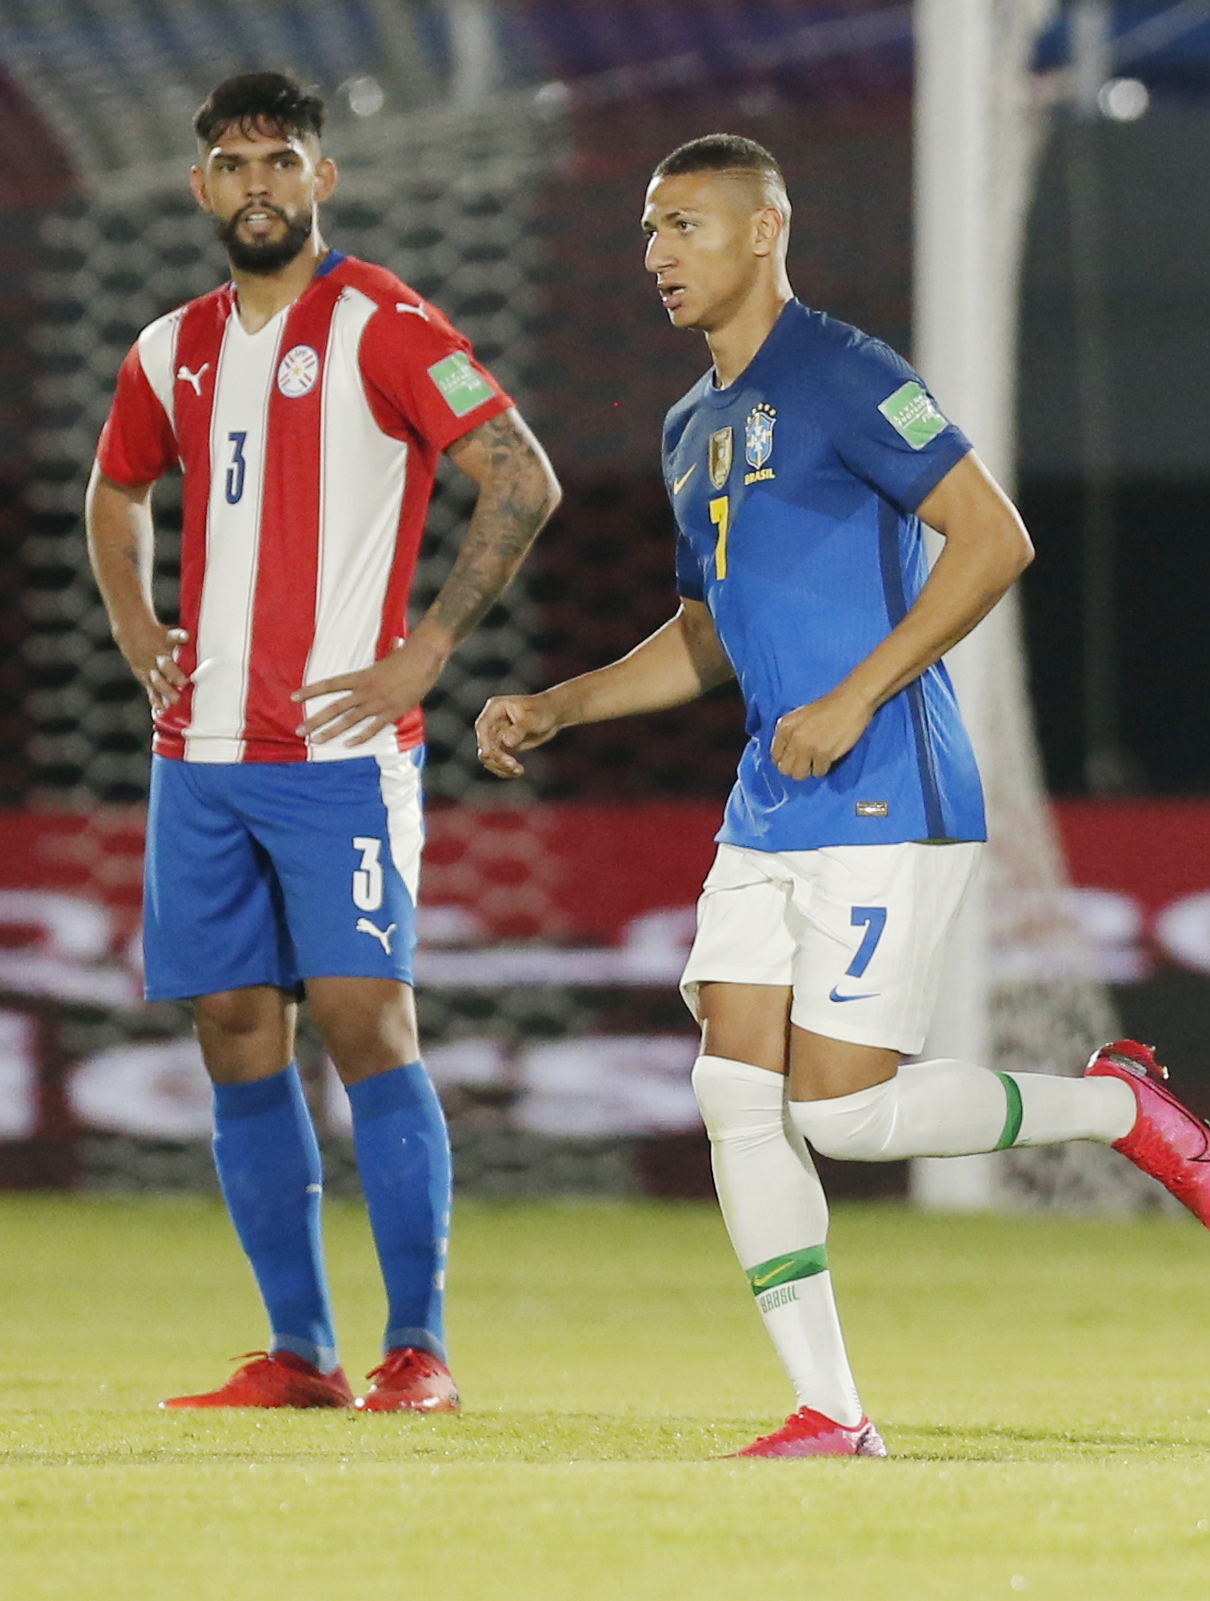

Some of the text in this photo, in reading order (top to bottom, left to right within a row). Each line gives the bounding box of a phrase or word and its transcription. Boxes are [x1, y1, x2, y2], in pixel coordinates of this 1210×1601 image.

[226, 431, 247, 505] 3
[744, 468, 776, 486] BRASIL
[708, 495, 729, 581] 7
[352, 836, 384, 912] 3
[844, 906, 887, 978] 7
[760, 1285, 800, 1314] BRASIL
